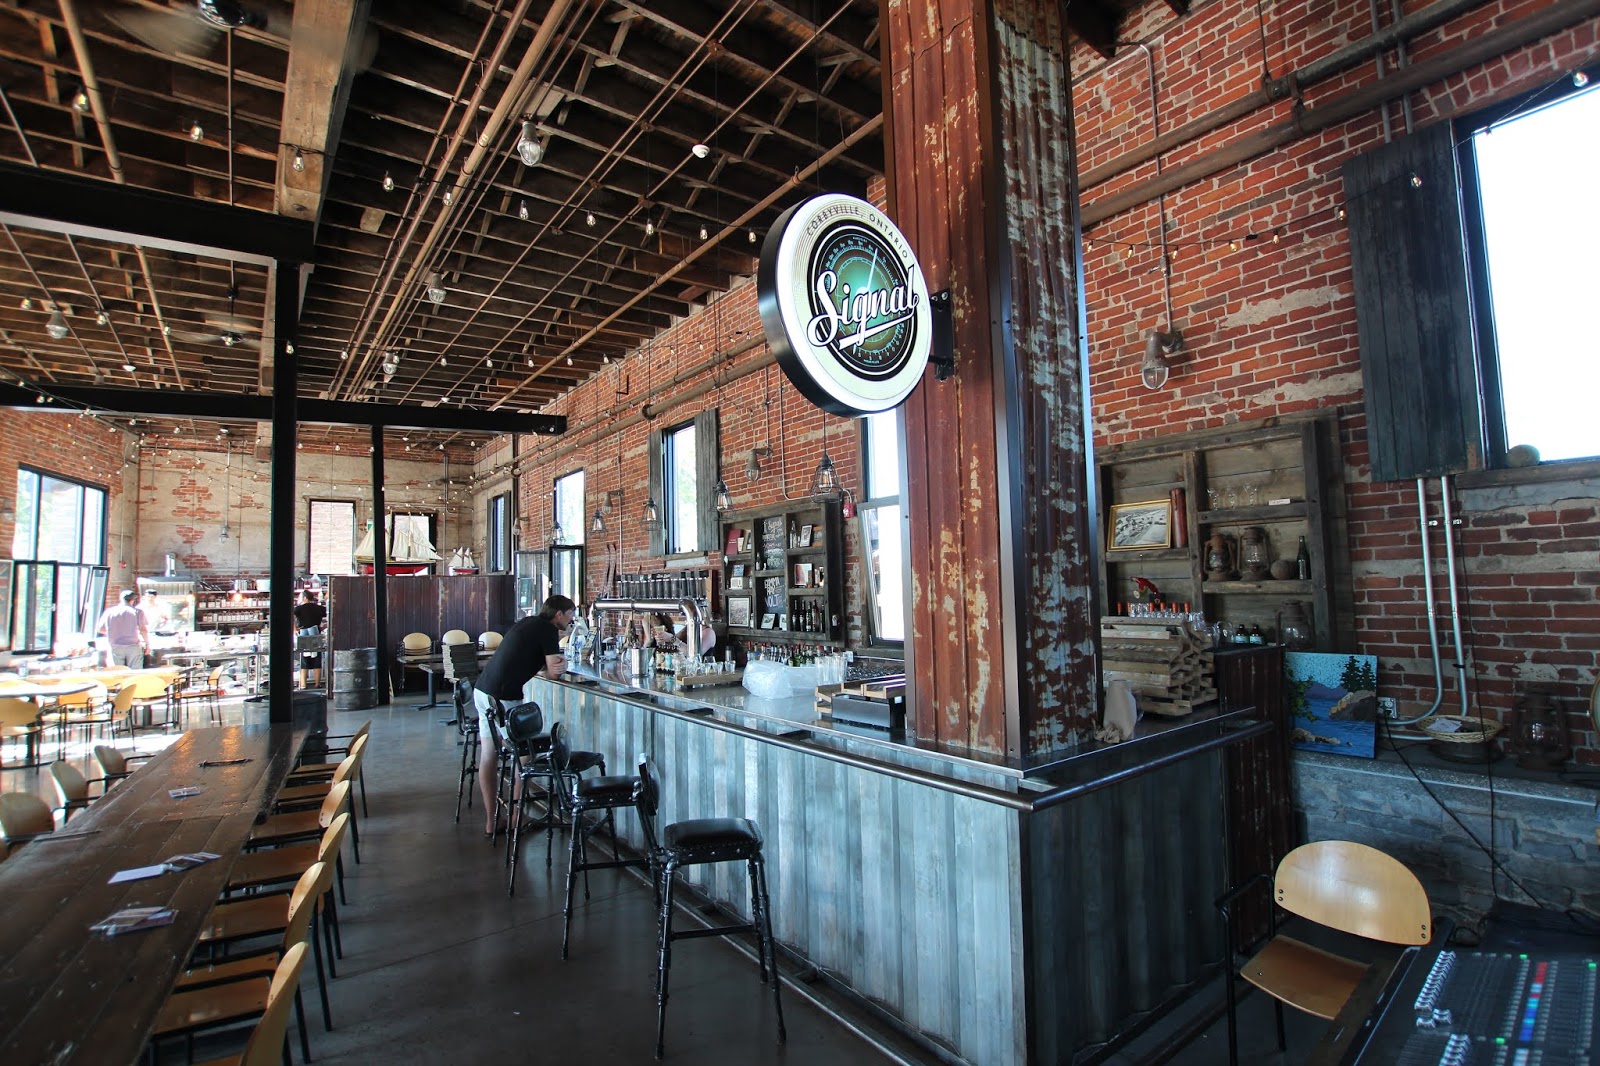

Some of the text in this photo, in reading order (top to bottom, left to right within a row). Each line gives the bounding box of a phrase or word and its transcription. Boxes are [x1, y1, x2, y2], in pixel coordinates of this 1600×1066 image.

[806, 205, 863, 236] CORBYVILLE,
[869, 213, 908, 258] ONTARIO
[807, 264, 919, 348] Signal
